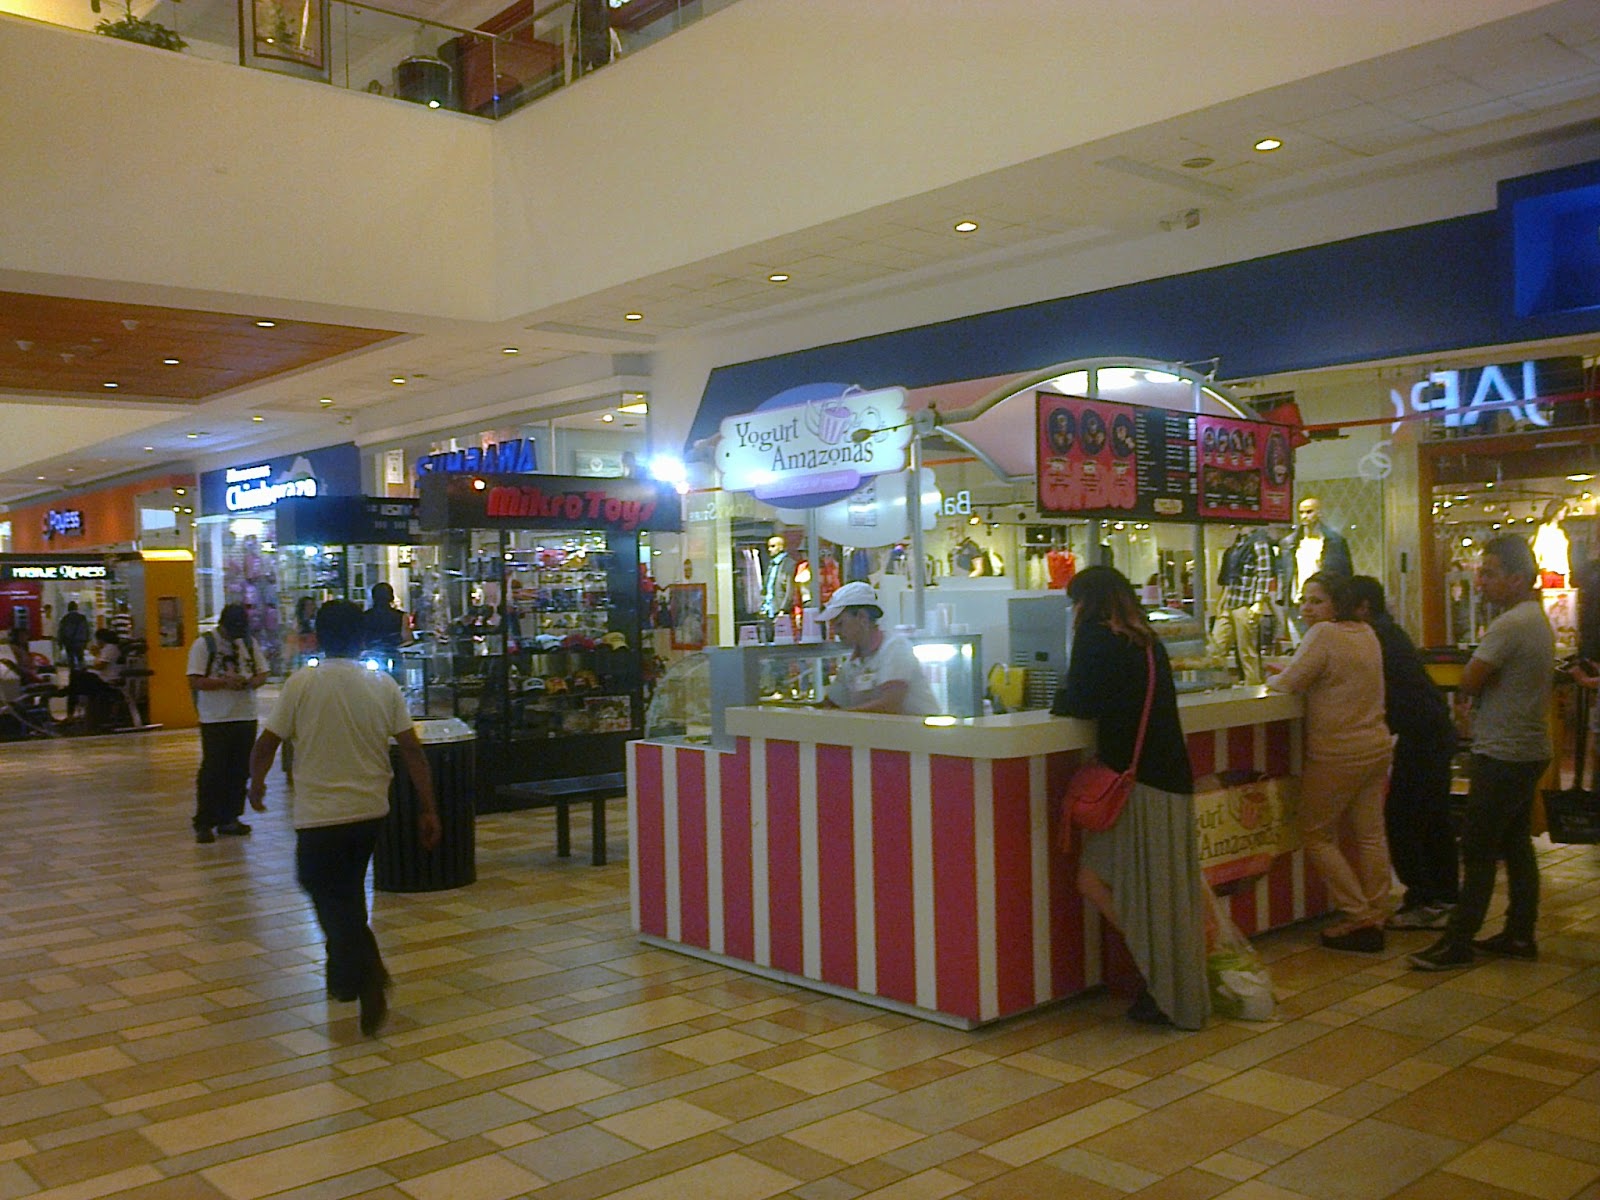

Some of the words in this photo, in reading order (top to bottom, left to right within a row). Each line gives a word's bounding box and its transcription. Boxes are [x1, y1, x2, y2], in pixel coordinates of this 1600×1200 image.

[735, 418, 799, 453] Yogurt
[771, 441, 874, 472] Amazonas
[487, 485, 582, 519] Mikro
[585, 490, 657, 531] Toys
